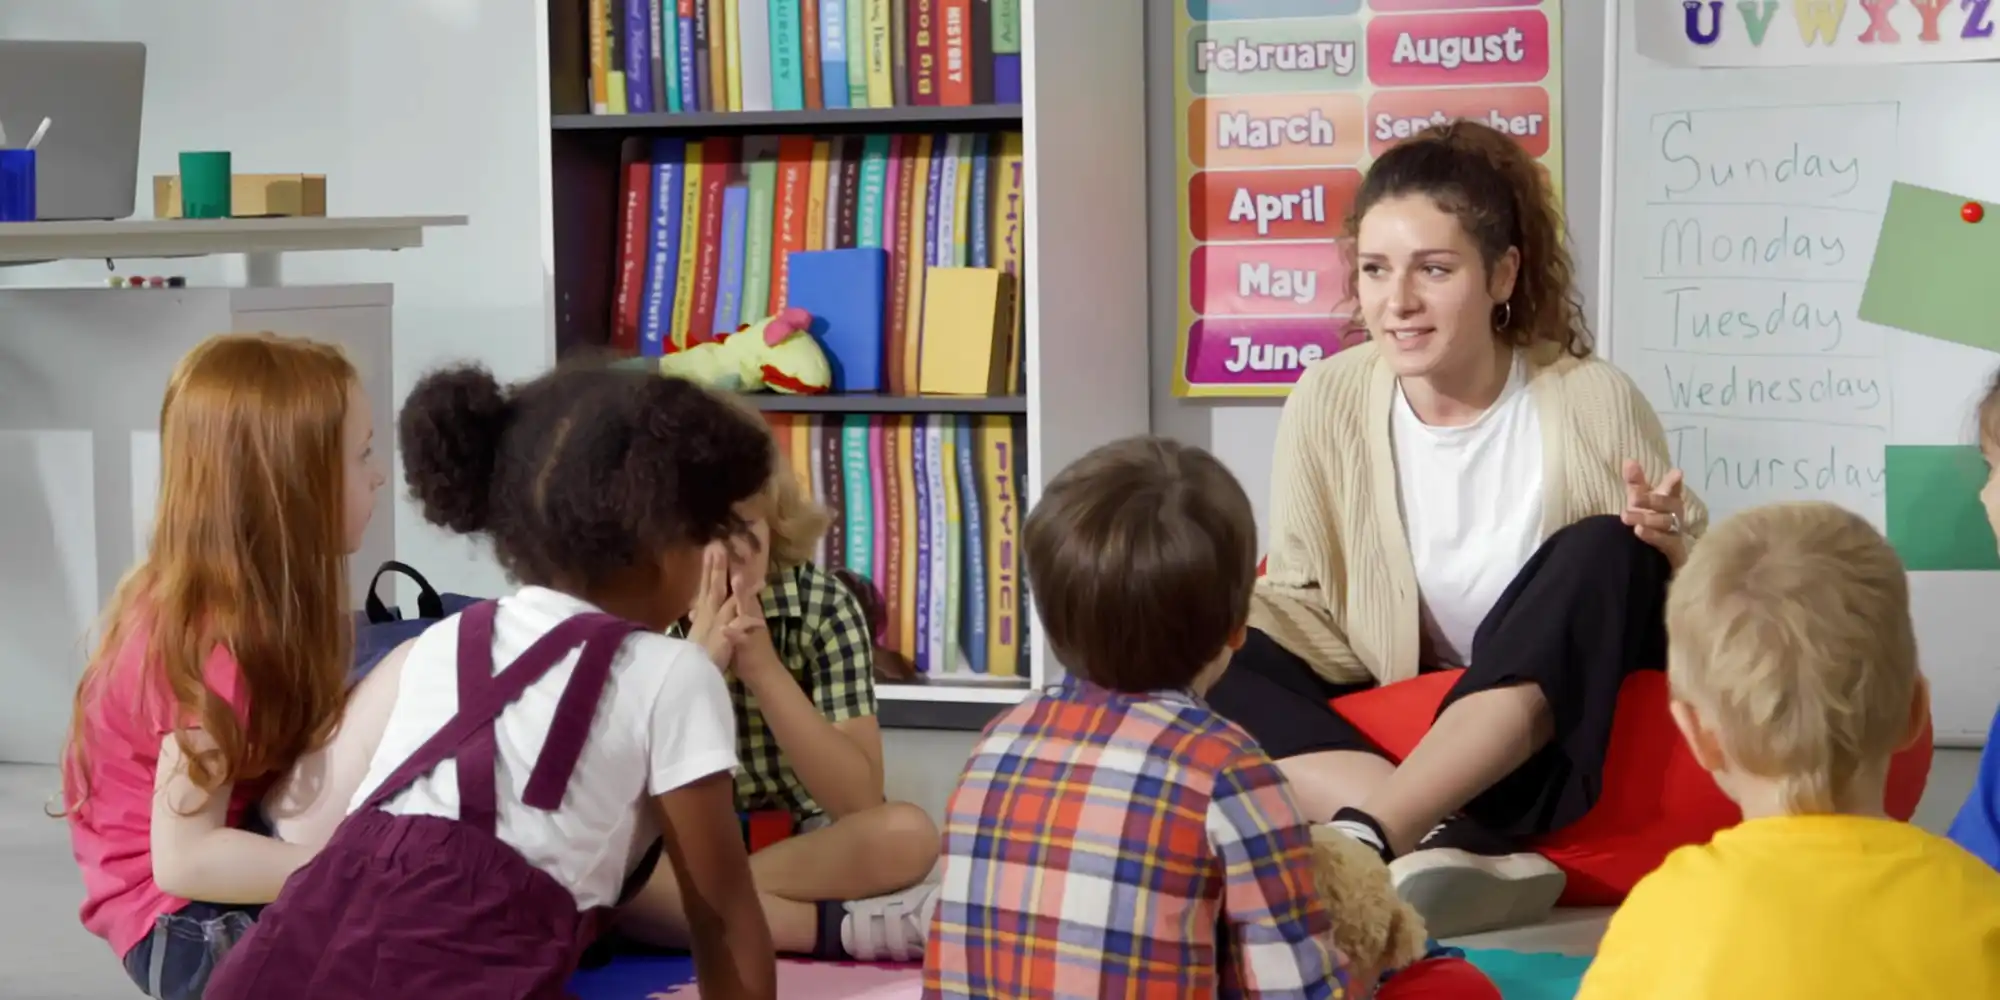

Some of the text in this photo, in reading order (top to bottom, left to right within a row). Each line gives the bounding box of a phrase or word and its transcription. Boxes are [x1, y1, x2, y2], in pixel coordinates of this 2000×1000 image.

[946, 6, 962, 83] HISTORY
[1683, 0, 1994, 47] U V W X Y Z
[1197, 39, 1356, 75] February
[1392, 27, 1525, 69] August
[917, 55, 933, 94] Big
[1217, 110, 1334, 148] March
[1661, 113, 1859, 198] Sunday
[706, 181, 719, 237] Vector
[1228, 185, 1325, 234] April
[1659, 217, 1845, 274] Monday
[646, 252, 668, 342] Relativity
[1239, 263, 1316, 304] May
[1663, 287, 1842, 351] Tuesday
[1225, 337, 1323, 373] June
[1664, 364, 1880, 410] Wednesday
[995, 442, 1013, 646] PHYSICS
